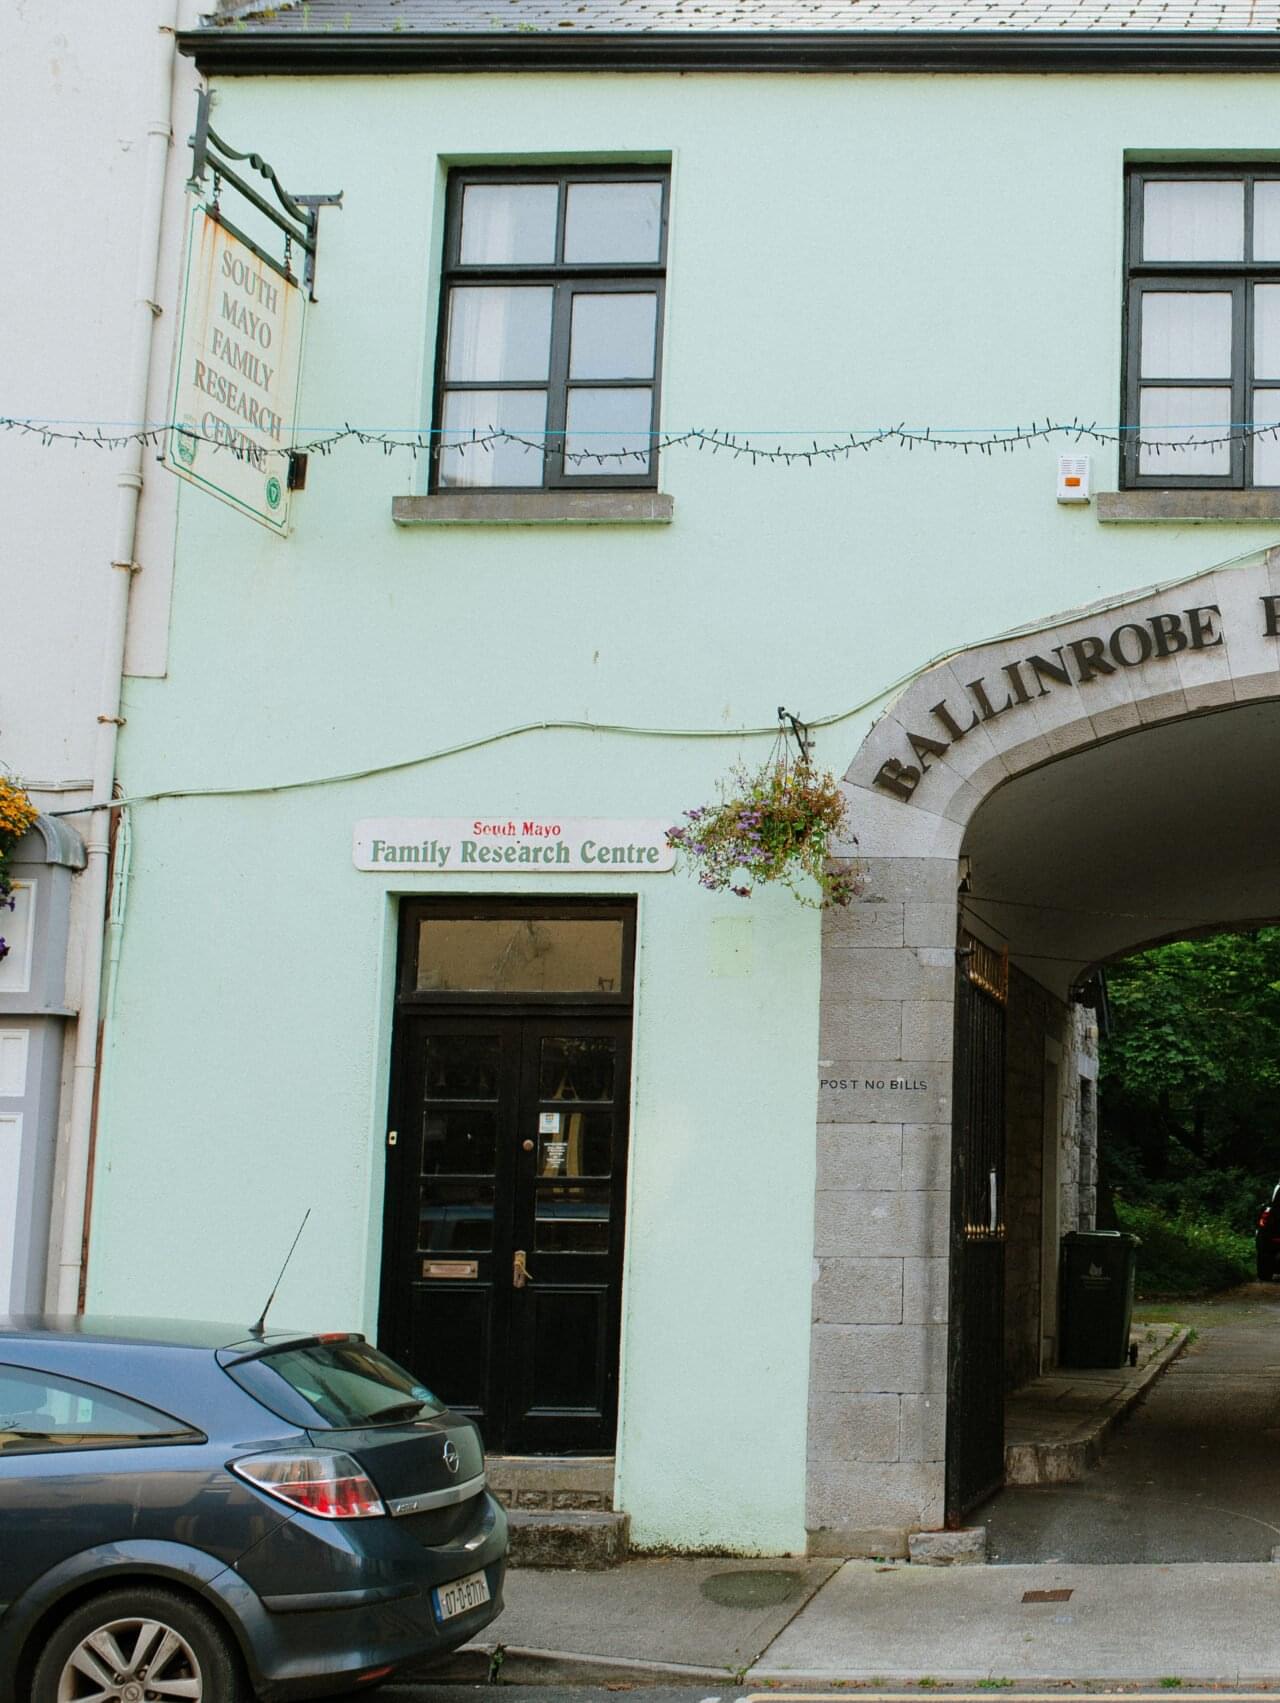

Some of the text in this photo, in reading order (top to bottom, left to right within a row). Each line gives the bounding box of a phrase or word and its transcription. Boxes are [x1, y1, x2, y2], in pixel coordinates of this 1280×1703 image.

[222, 249, 279, 315] SOUTH
[221, 291, 272, 349] MAYO
[211, 327, 275, 392] FAMILY
[193, 358, 283, 443] RESEARCH
[872, 604, 1225, 803] BALLINROBE
[370, 839, 660, 868] Family Research Centre
[472, 820, 562, 839] South Mayo
[819, 1079, 929, 1091] POST NO BILLS
